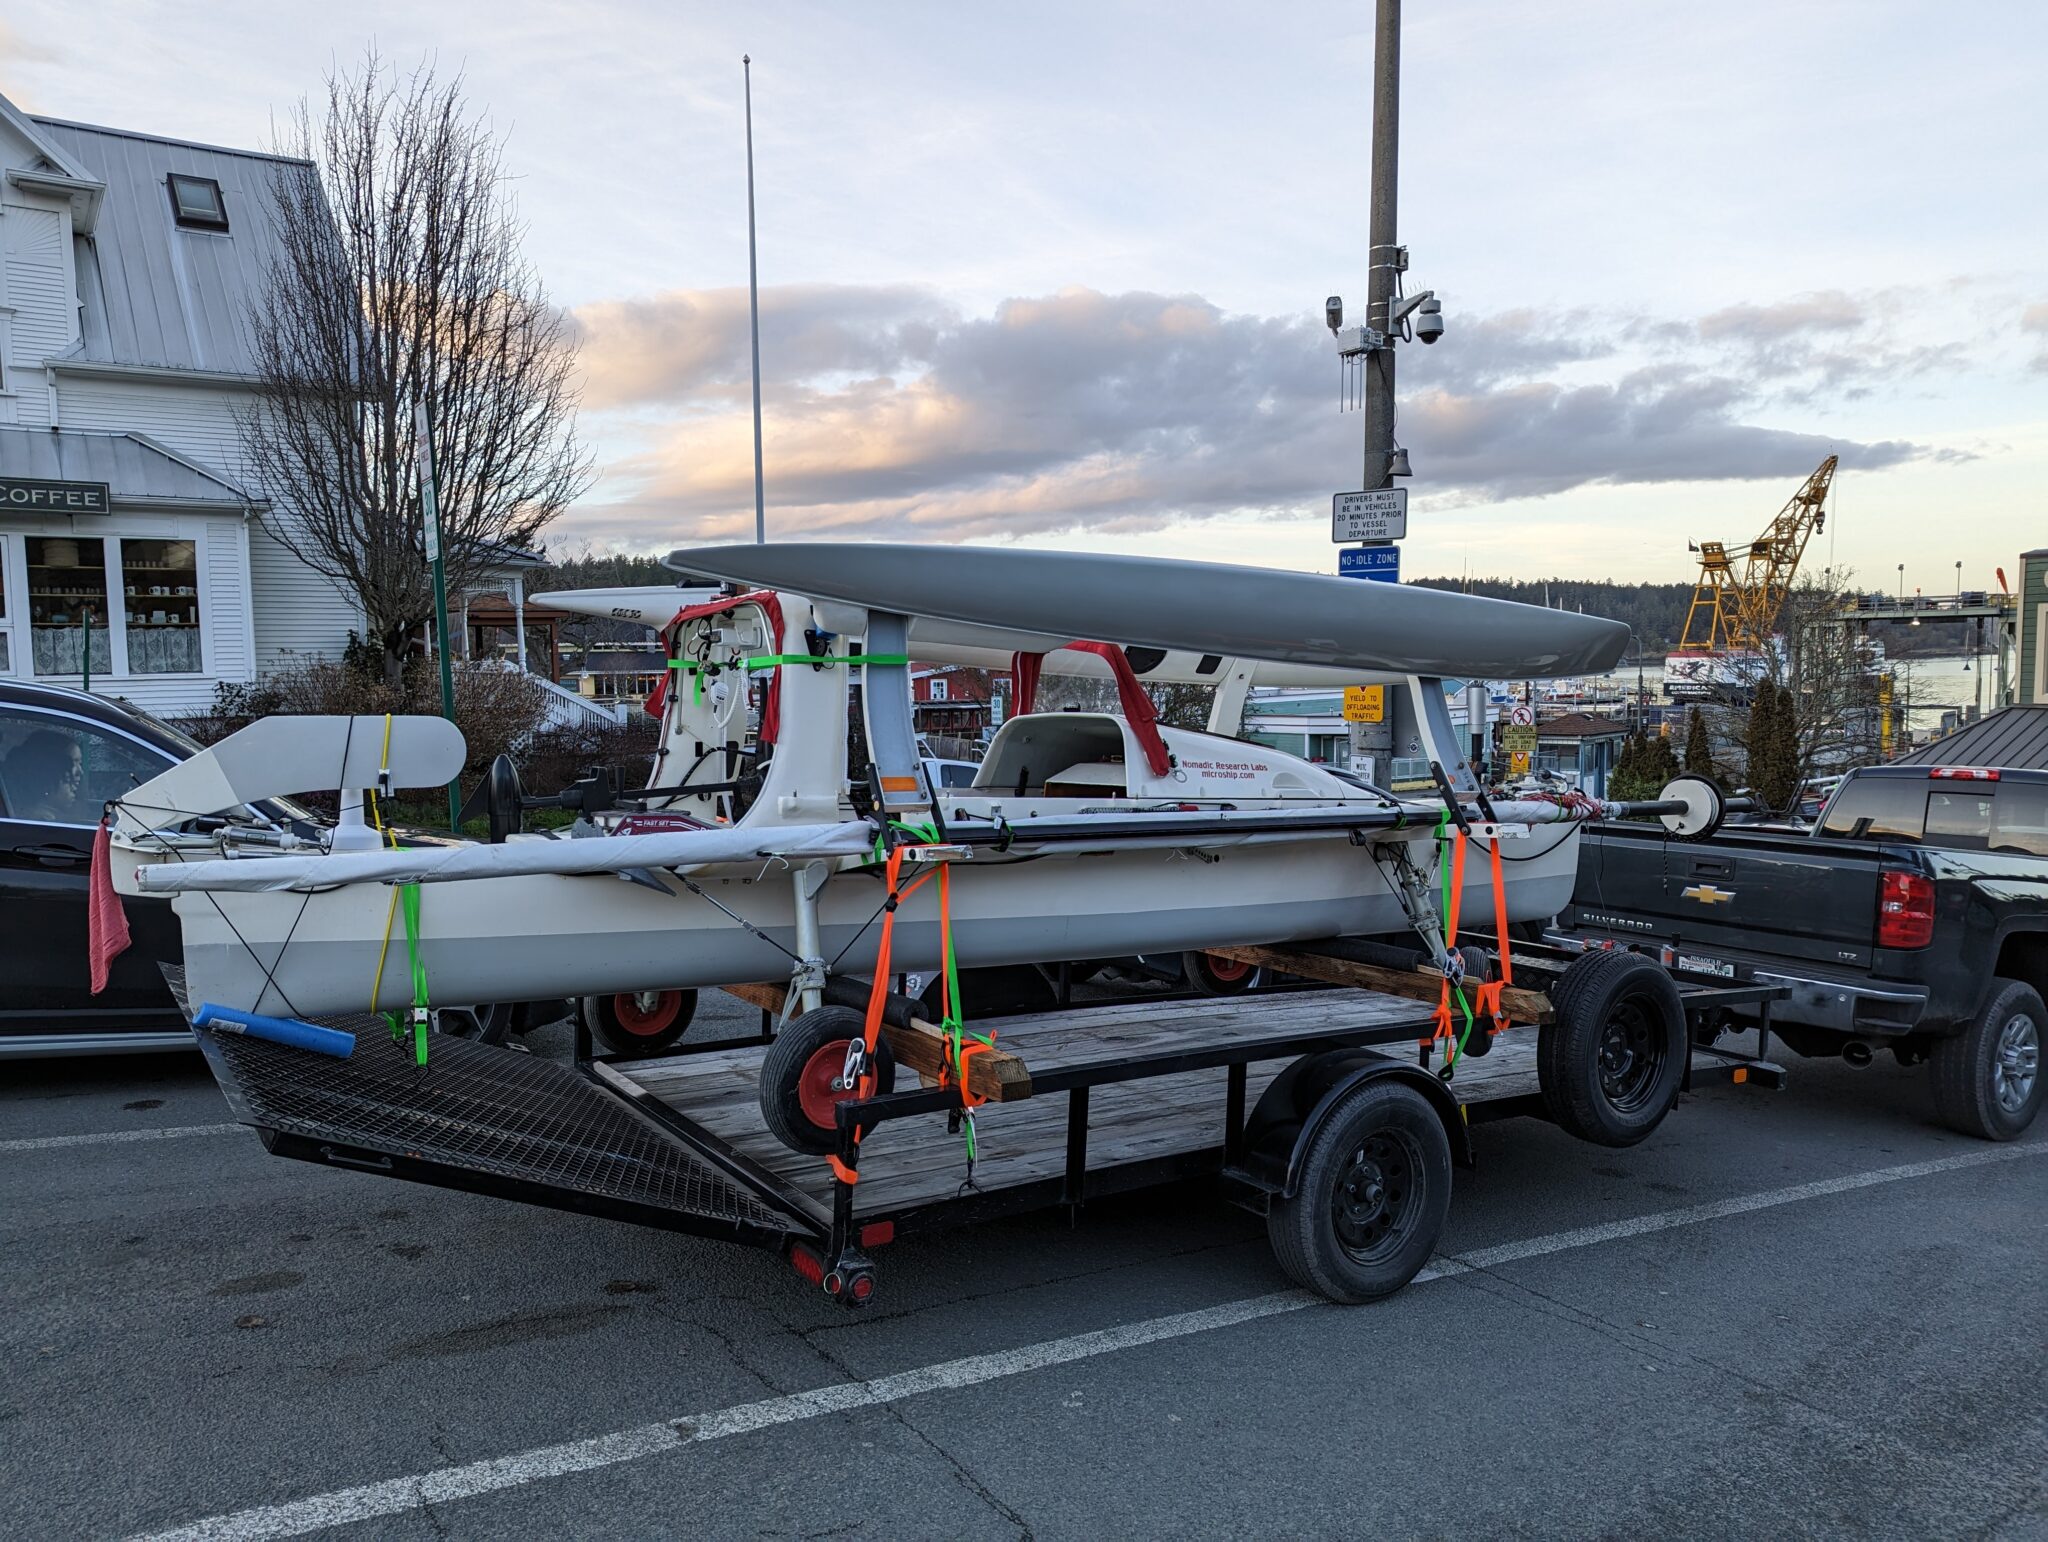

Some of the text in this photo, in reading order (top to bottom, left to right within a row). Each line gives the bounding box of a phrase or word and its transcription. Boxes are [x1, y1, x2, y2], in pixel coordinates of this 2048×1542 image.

[1344, 493, 1395, 504] DRIVERS MUST
[1342, 502, 1397, 513] BE IN VEHICLES
[1337, 510, 1402, 522] 20 MINUTES PRIOR
[1362, 520, 1388, 528] VESSEL
[1348, 529, 1388, 538] DEPARTURE
[1341, 553, 1397, 566] NO-IDLE ZONE
[993, 699, 1001, 708] 30
[1351, 712, 1375, 720] TRAFFIC
[1182, 760, 1268, 771] Nomadic Research Labs
[1583, 913, 1653, 929] SILVERADO
[1838, 951, 1857, 960] LTZ
